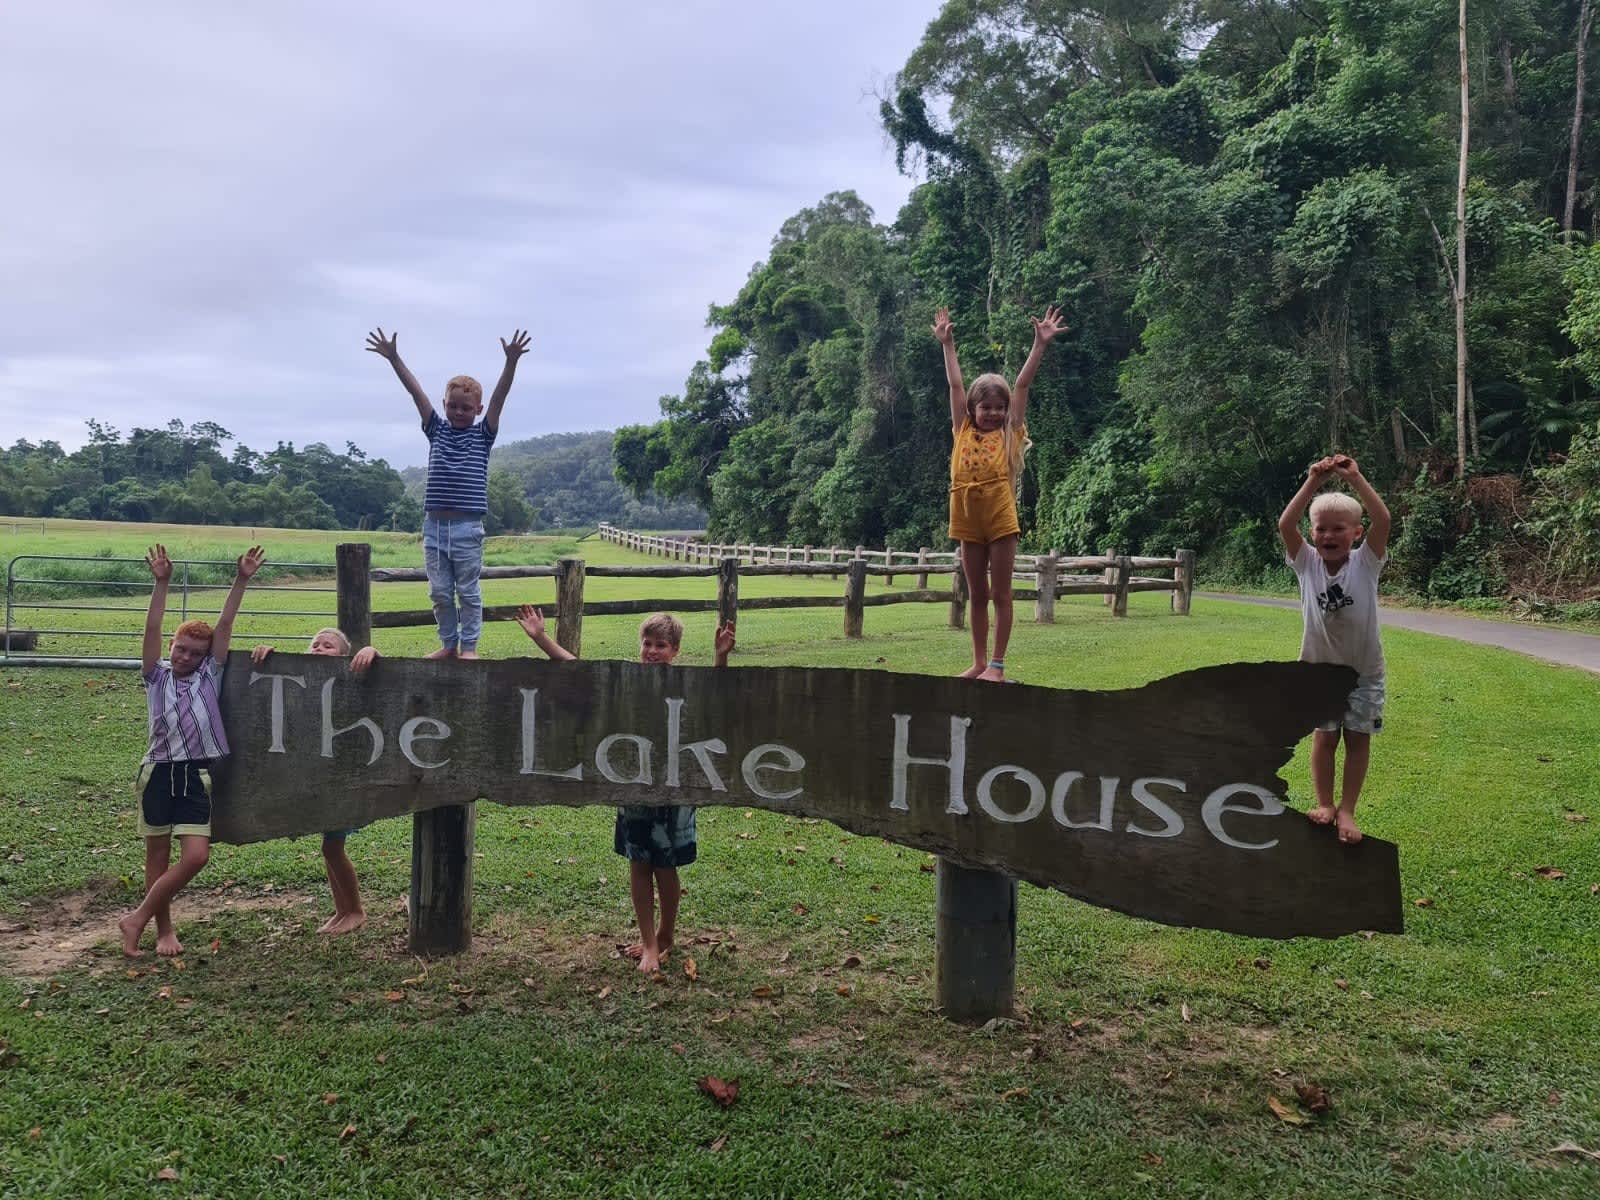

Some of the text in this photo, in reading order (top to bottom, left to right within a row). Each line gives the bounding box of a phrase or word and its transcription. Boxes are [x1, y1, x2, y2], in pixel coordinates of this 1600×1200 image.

[249, 672, 1286, 850] The Lake House
